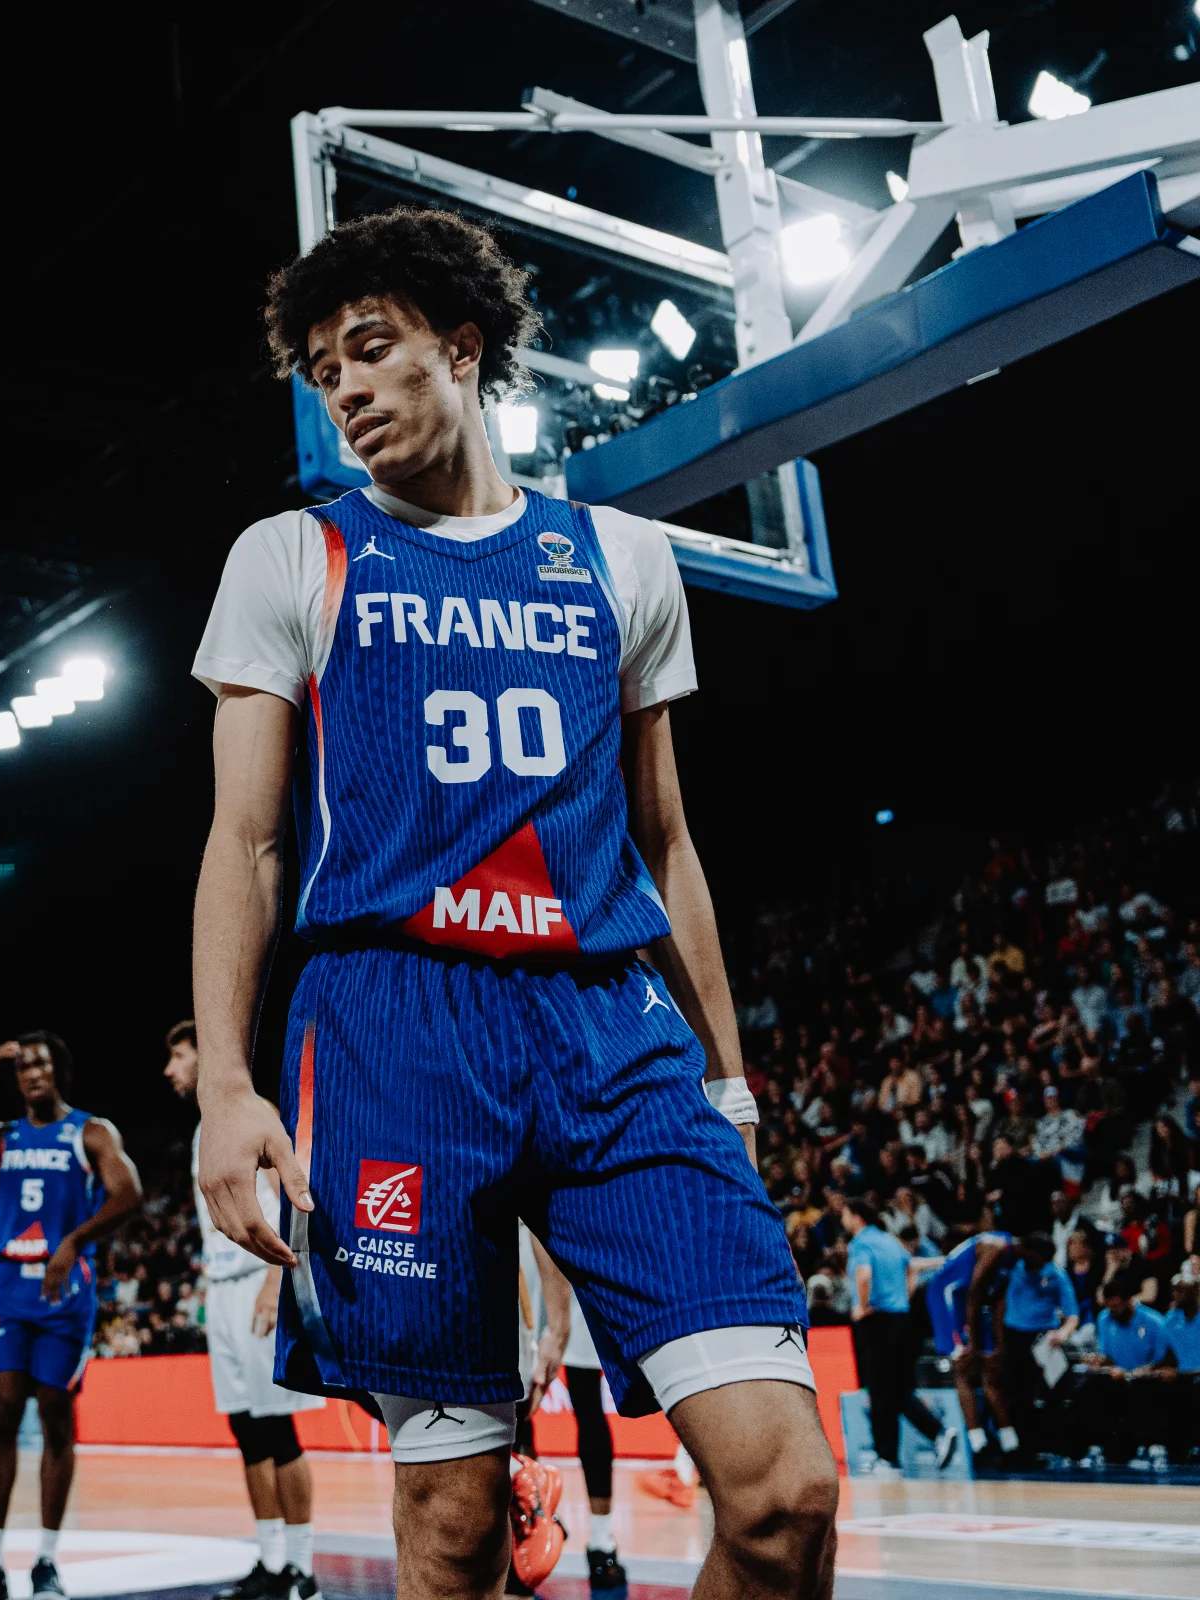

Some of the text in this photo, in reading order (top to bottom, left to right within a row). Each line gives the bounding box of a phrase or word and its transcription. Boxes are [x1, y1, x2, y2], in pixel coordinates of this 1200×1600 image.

[539, 566, 588, 576] EUROBASKET
[355, 592, 597, 660] FRANCE
[423, 687, 567, 784] 30
[432, 886, 562, 936] MAIF
[1, 1148, 72, 1172] FRANCE
[20, 1178, 44, 1212] 5
[334, 1246, 437, 1279] D'EPARGNE
[357, 1236, 415, 1259] CAISSE
